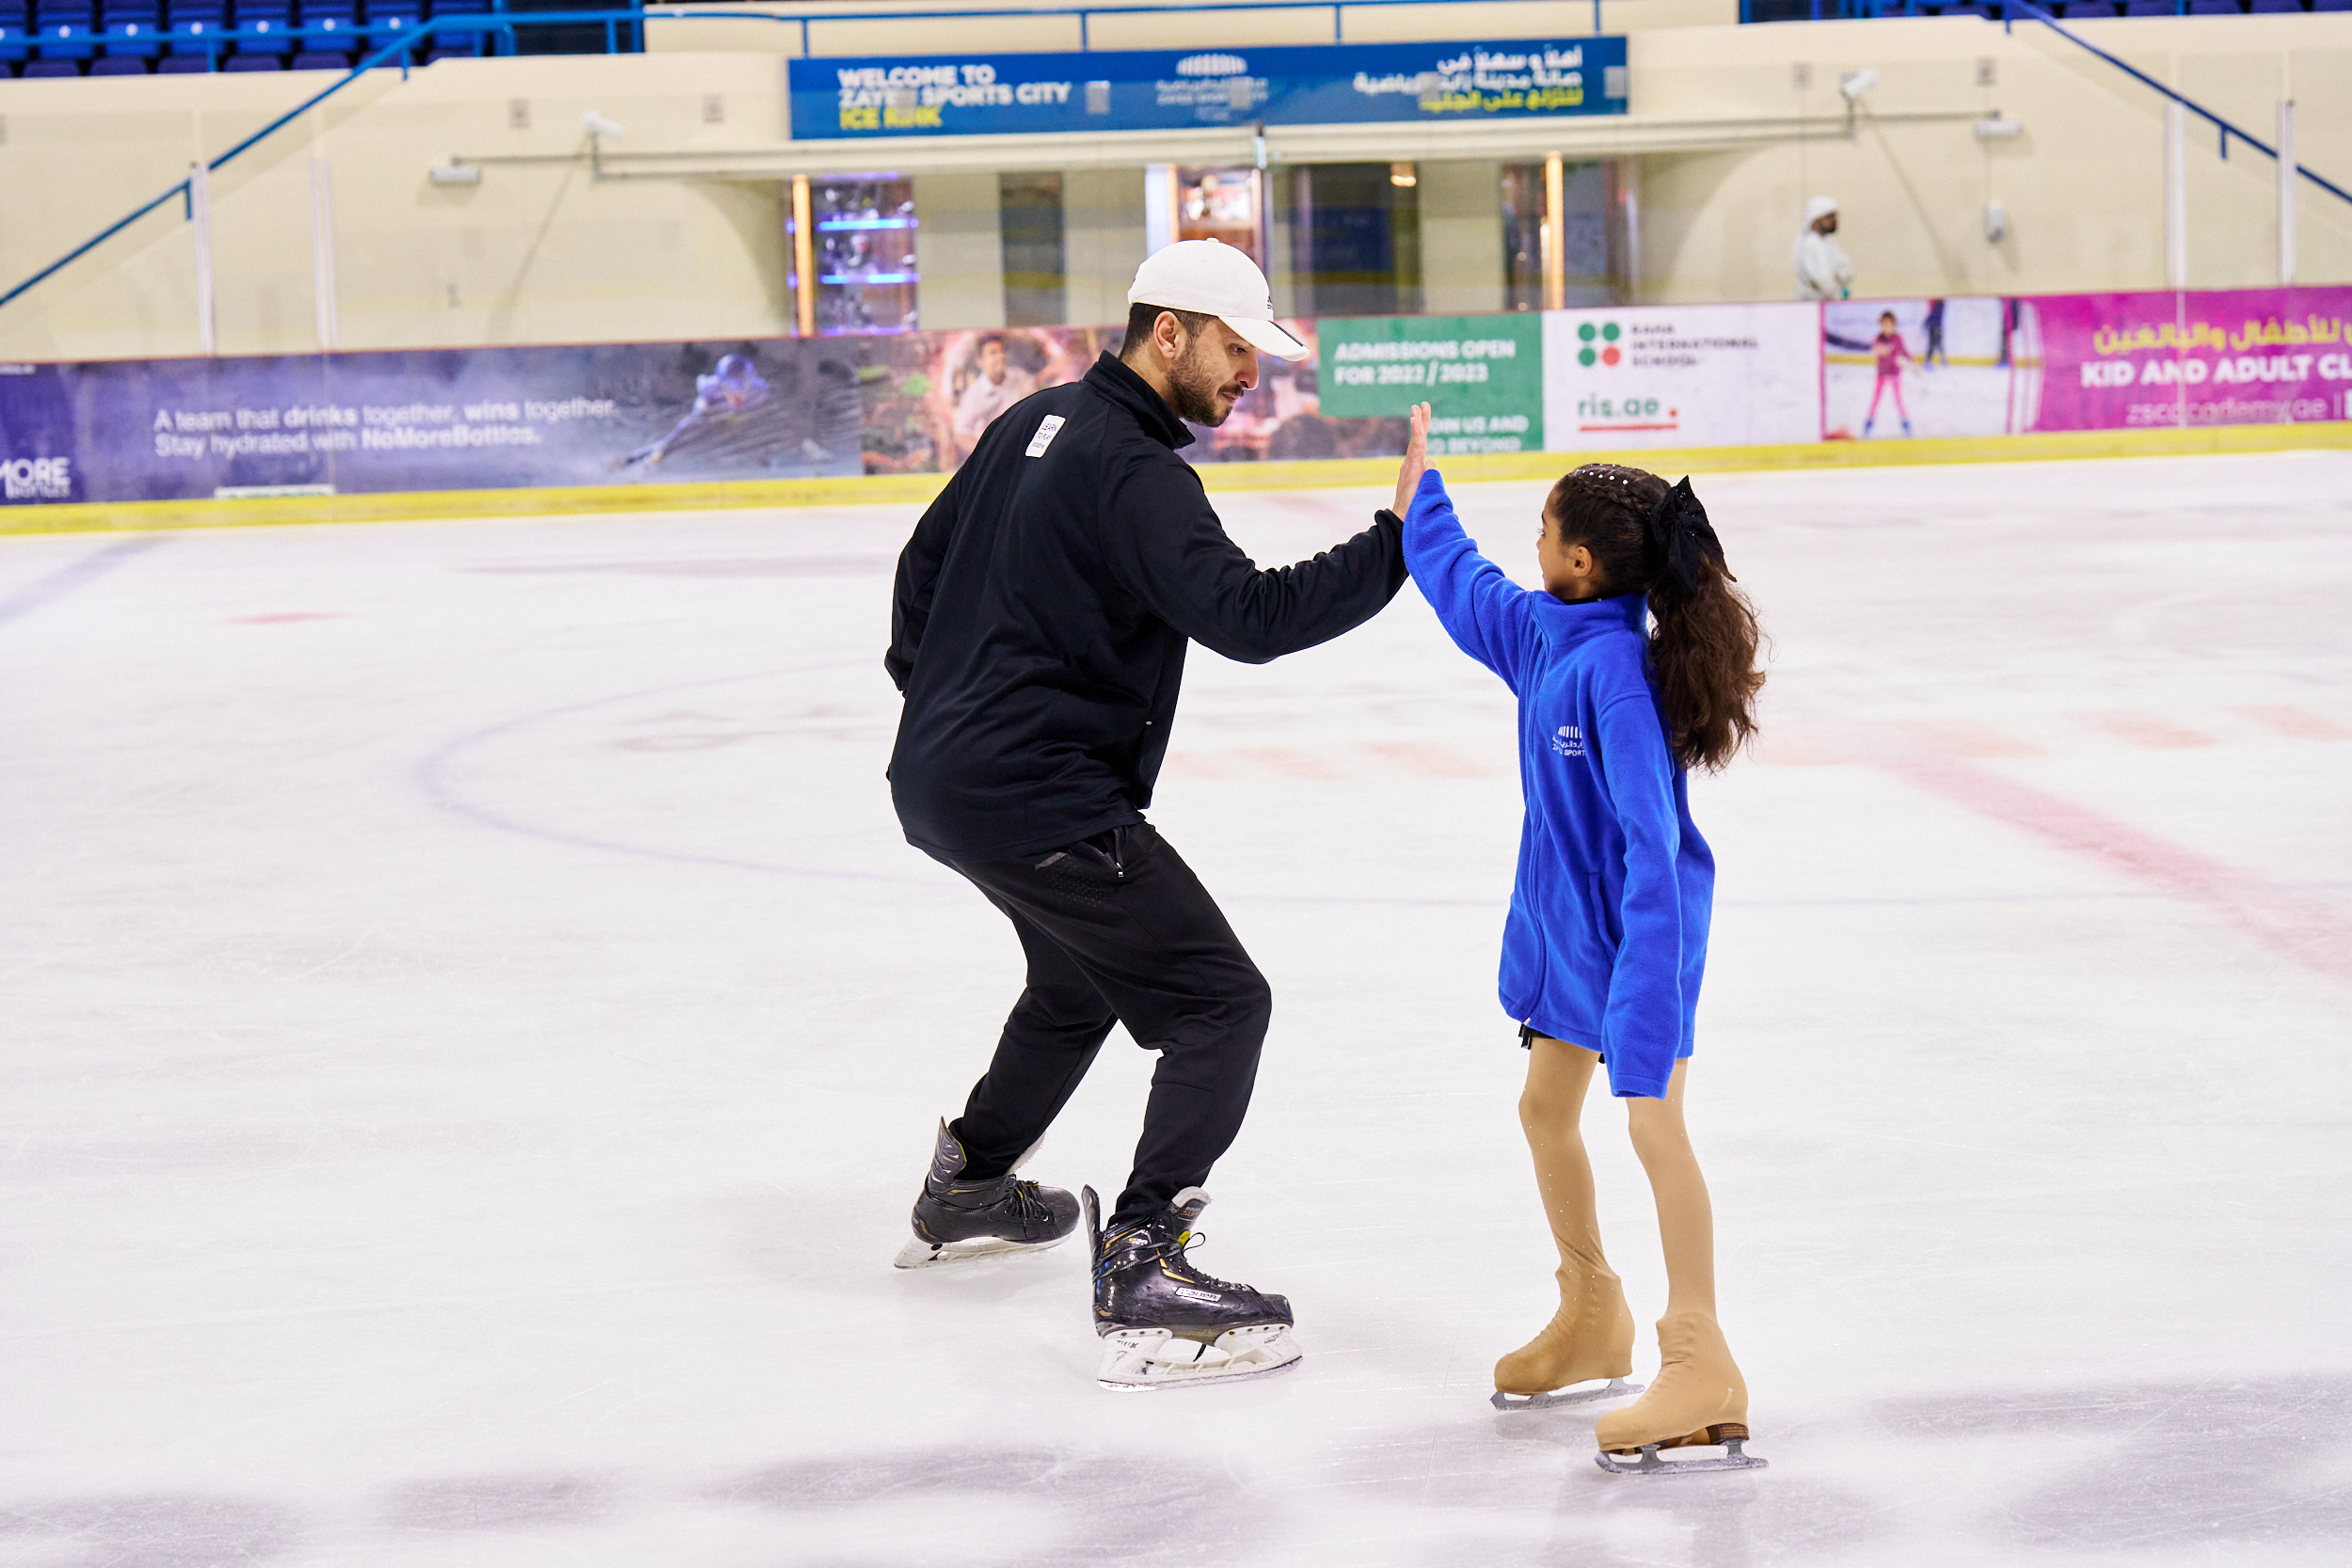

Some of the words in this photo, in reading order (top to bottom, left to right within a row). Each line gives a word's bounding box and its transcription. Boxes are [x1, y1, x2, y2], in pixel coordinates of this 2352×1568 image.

[837, 65, 958, 87] WELCOME
[961, 64, 996, 86] TO
[1437, 52, 1472, 75] في
[839, 86, 917, 108] ZAYE
[921, 83, 1013, 106] SPORTS
[1016, 81, 1072, 104] CITY
[839, 106, 880, 129] ICE
[2229, 313, 2341, 352] للأطفال
[1334, 341, 1459, 362] ADMISSIONS
[1461, 339, 1516, 359] OPEN
[1334, 365, 1375, 386] FOR
[1439, 362, 1488, 384] 2023
[2080, 360, 2136, 388] KID
[2139, 357, 2209, 386] AND
[2213, 354, 2313, 385] ADULT
[153, 408, 173, 432] A
[175, 411, 232, 432] team
[236, 407, 279, 430] that
[283, 404, 359, 428] drinks
[463, 399, 519, 421] wins
[1578, 393, 1660, 417] ris.ae
[1427, 417, 1460, 434] OIN
[1462, 416, 1486, 434] US
[1489, 414, 1529, 433] AND
[155, 432, 206, 460] Stay
[211, 430, 308, 460] hydrated
[311, 429, 358, 451] with
[1427, 437, 1446, 454] O
[1447, 436, 1521, 453] BEYOND
